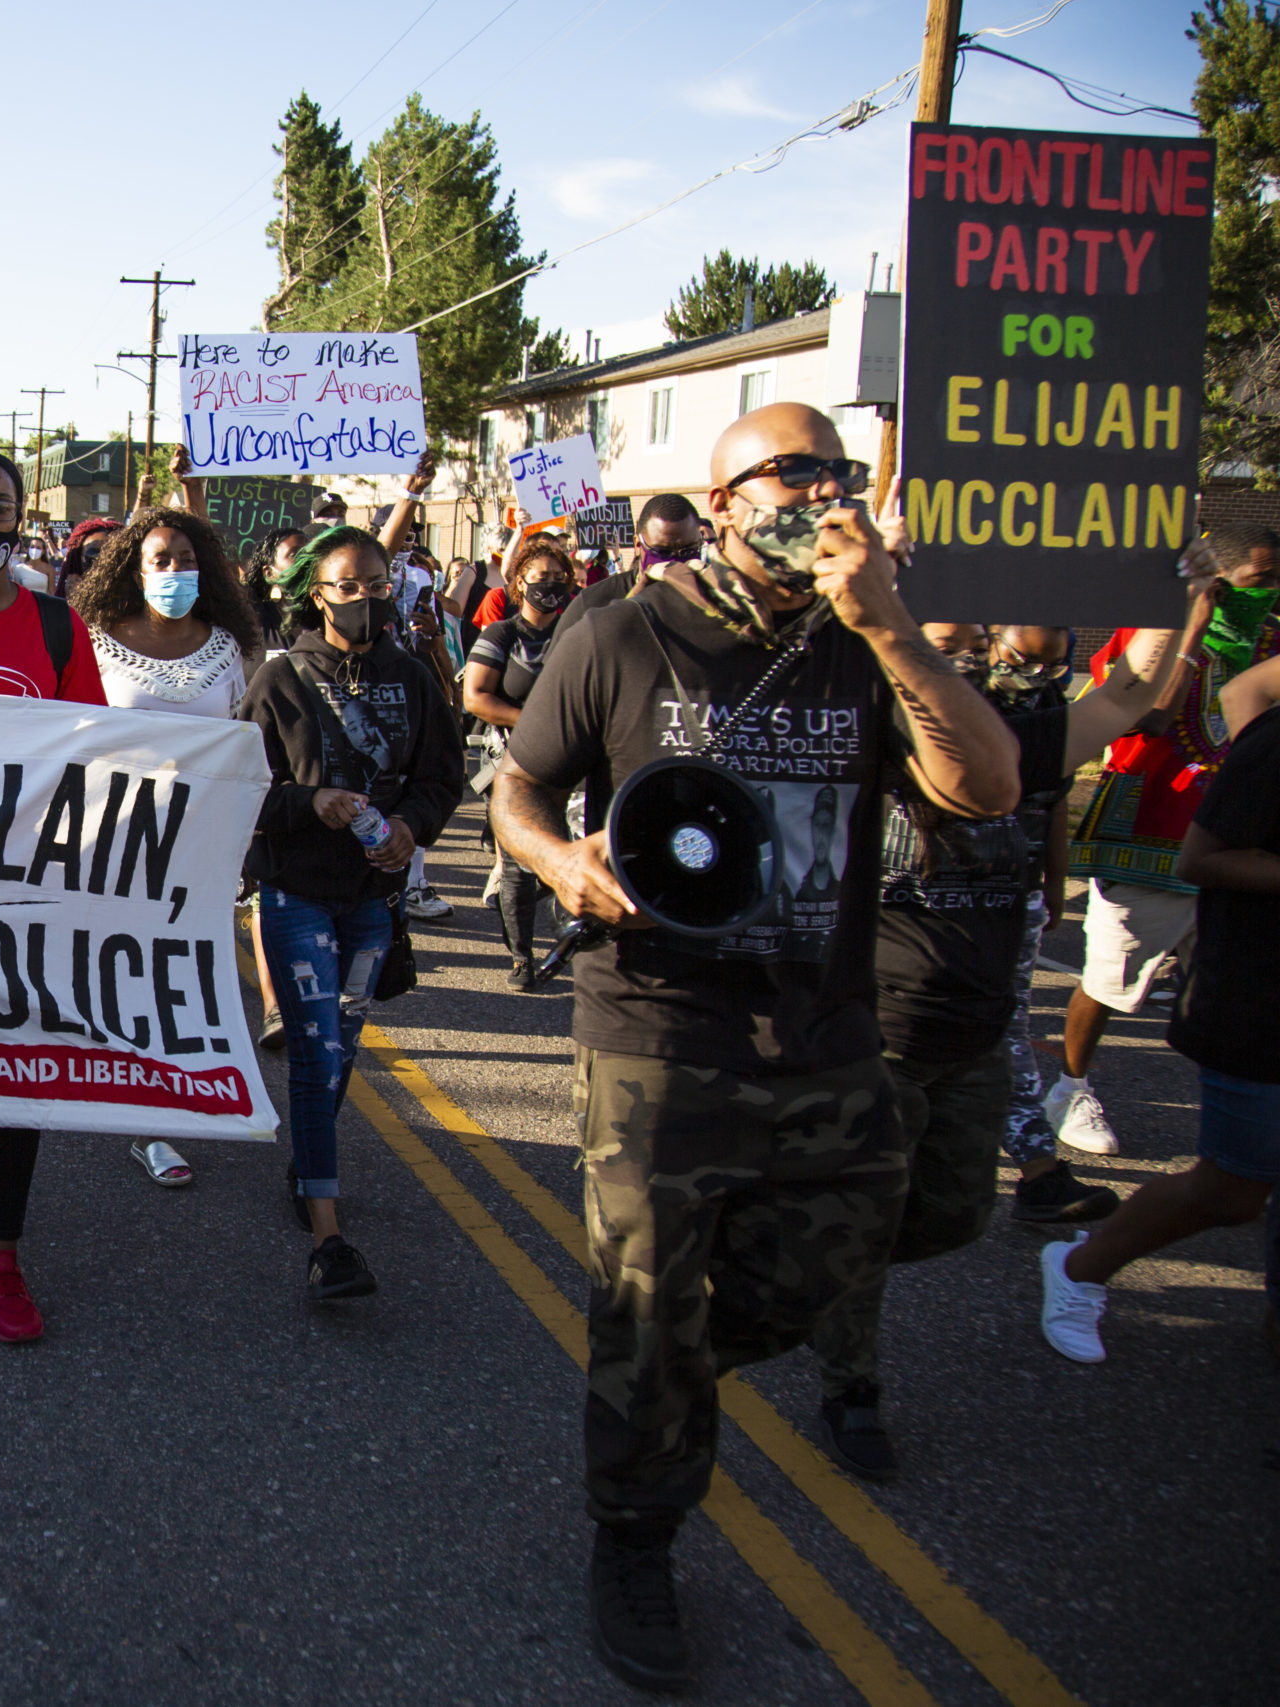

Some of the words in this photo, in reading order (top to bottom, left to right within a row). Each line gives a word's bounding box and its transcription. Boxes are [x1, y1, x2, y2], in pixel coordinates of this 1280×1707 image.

[913, 133, 1211, 217] FRONTLINE
[955, 221, 1155, 296] PARTY
[179, 334, 240, 369] Here
[257, 337, 290, 367] to
[1002, 313, 1095, 359] FOR
[190, 369, 308, 411] RACIST
[315, 369, 422, 405] America
[946, 375, 1182, 450] ELIJAH
[183, 411, 420, 470] Uncomfortable
[208, 476, 306, 508] Justice
[538, 475, 567, 501] for
[551, 478, 599, 518] Elijah
[207, 498, 294, 536] Elijah
[906, 478, 1187, 549] MCCLAIN
[578, 525, 595, 546] NO
[596, 524, 634, 545] PEACE
[660, 700, 793, 735] TME'S
[805, 707, 859, 737] UP!
[675, 750, 849, 776] PARTMENT
[776, 737, 860, 755] POLICE
[68, 1057, 239, 1101] LIBERATION
